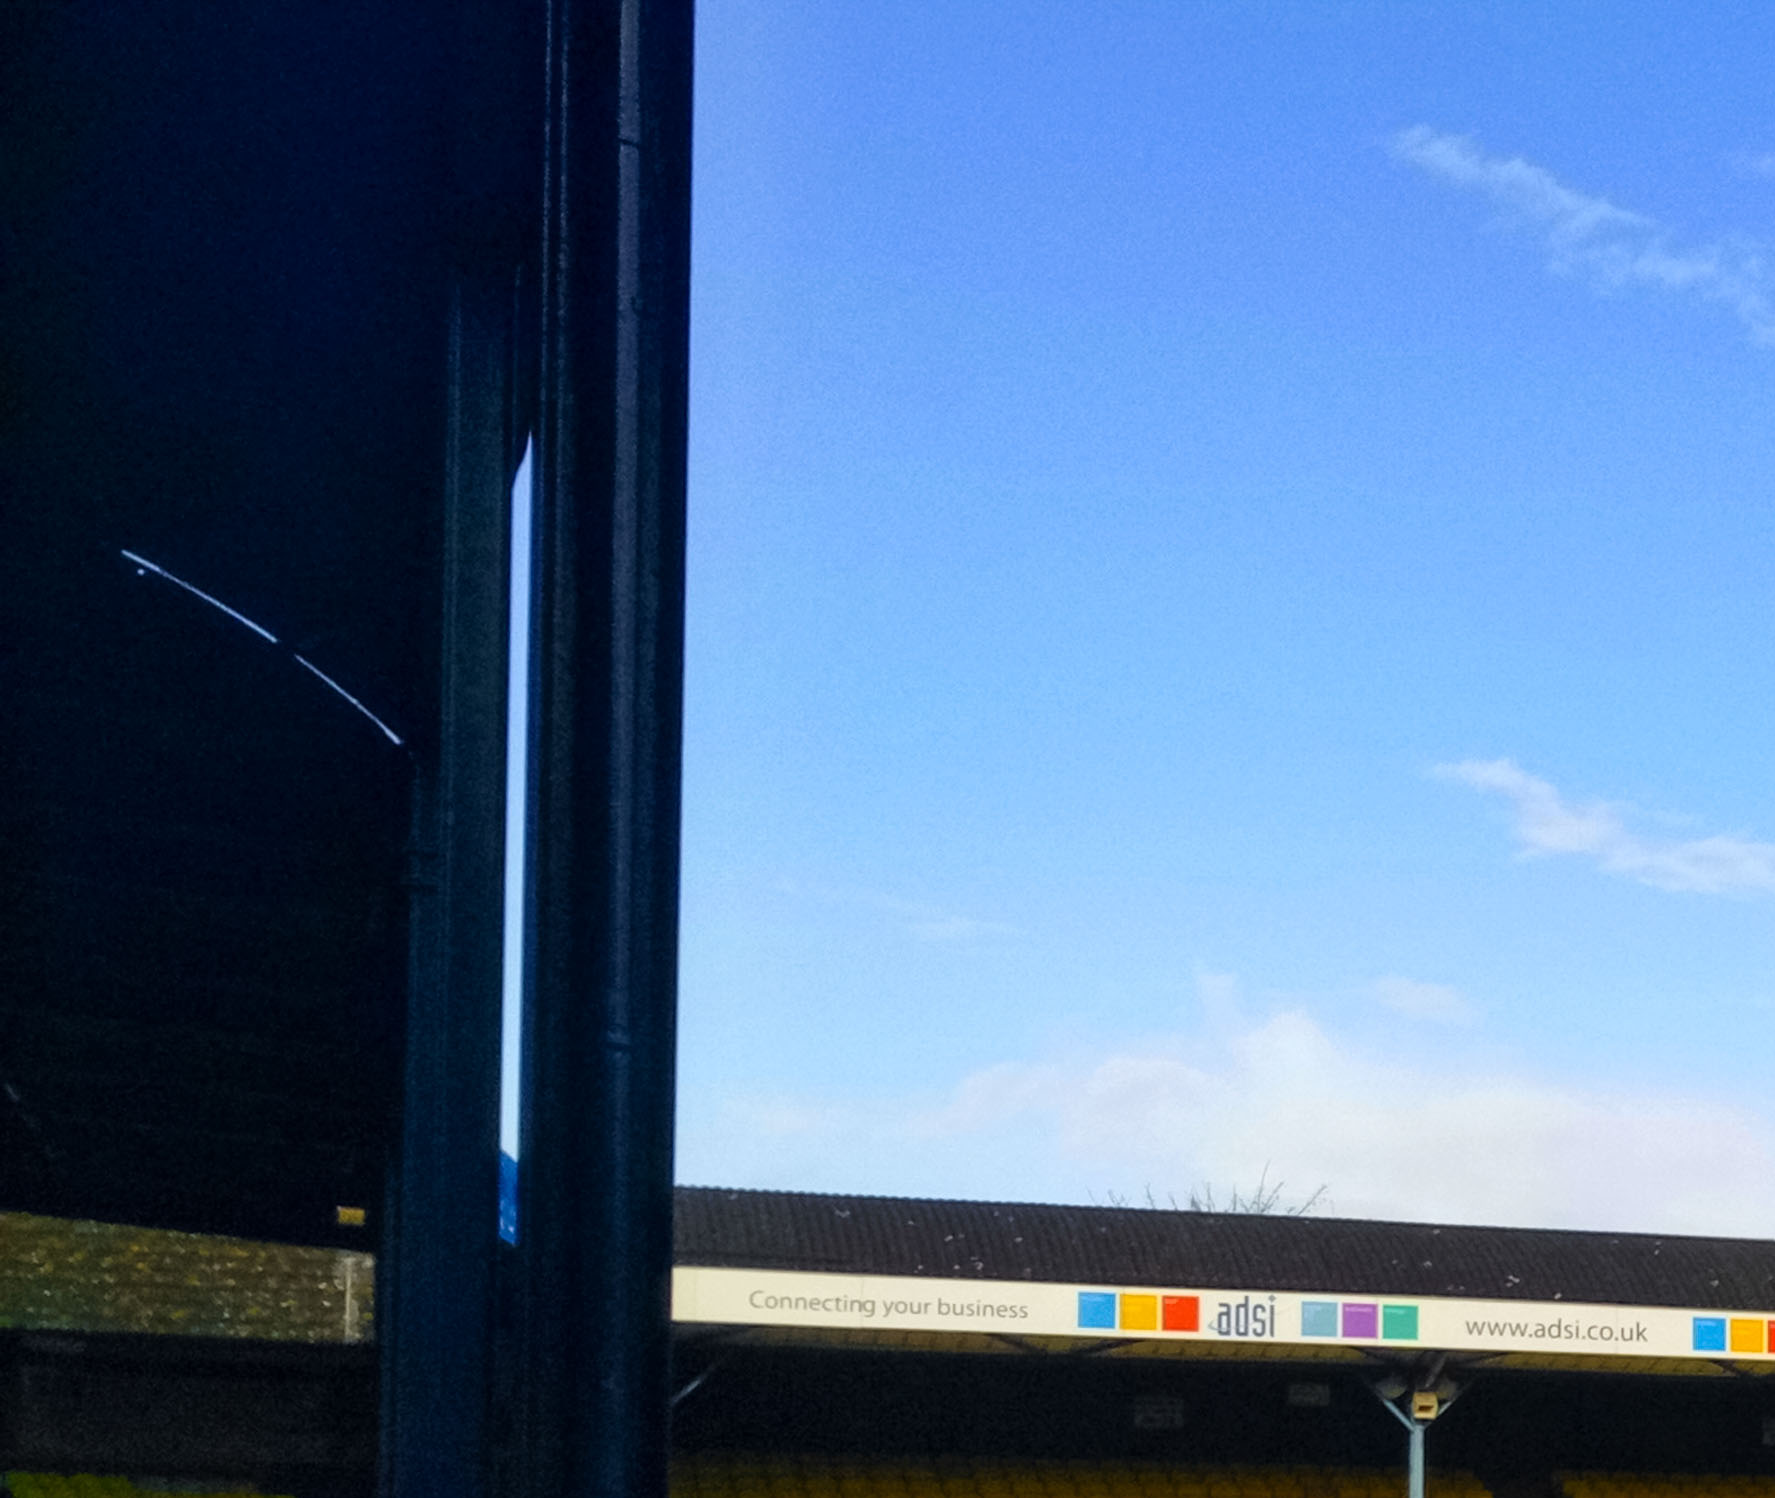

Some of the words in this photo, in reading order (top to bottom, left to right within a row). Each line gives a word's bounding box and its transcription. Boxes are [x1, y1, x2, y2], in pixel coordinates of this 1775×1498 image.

[749, 1289, 876, 1317] Connecting
[882, 1299, 931, 1317] your
[937, 1298, 1029, 1319] business
[1216, 1294, 1276, 1337] adsi
[1465, 1318, 1648, 1342] www.adsi.co.uk
